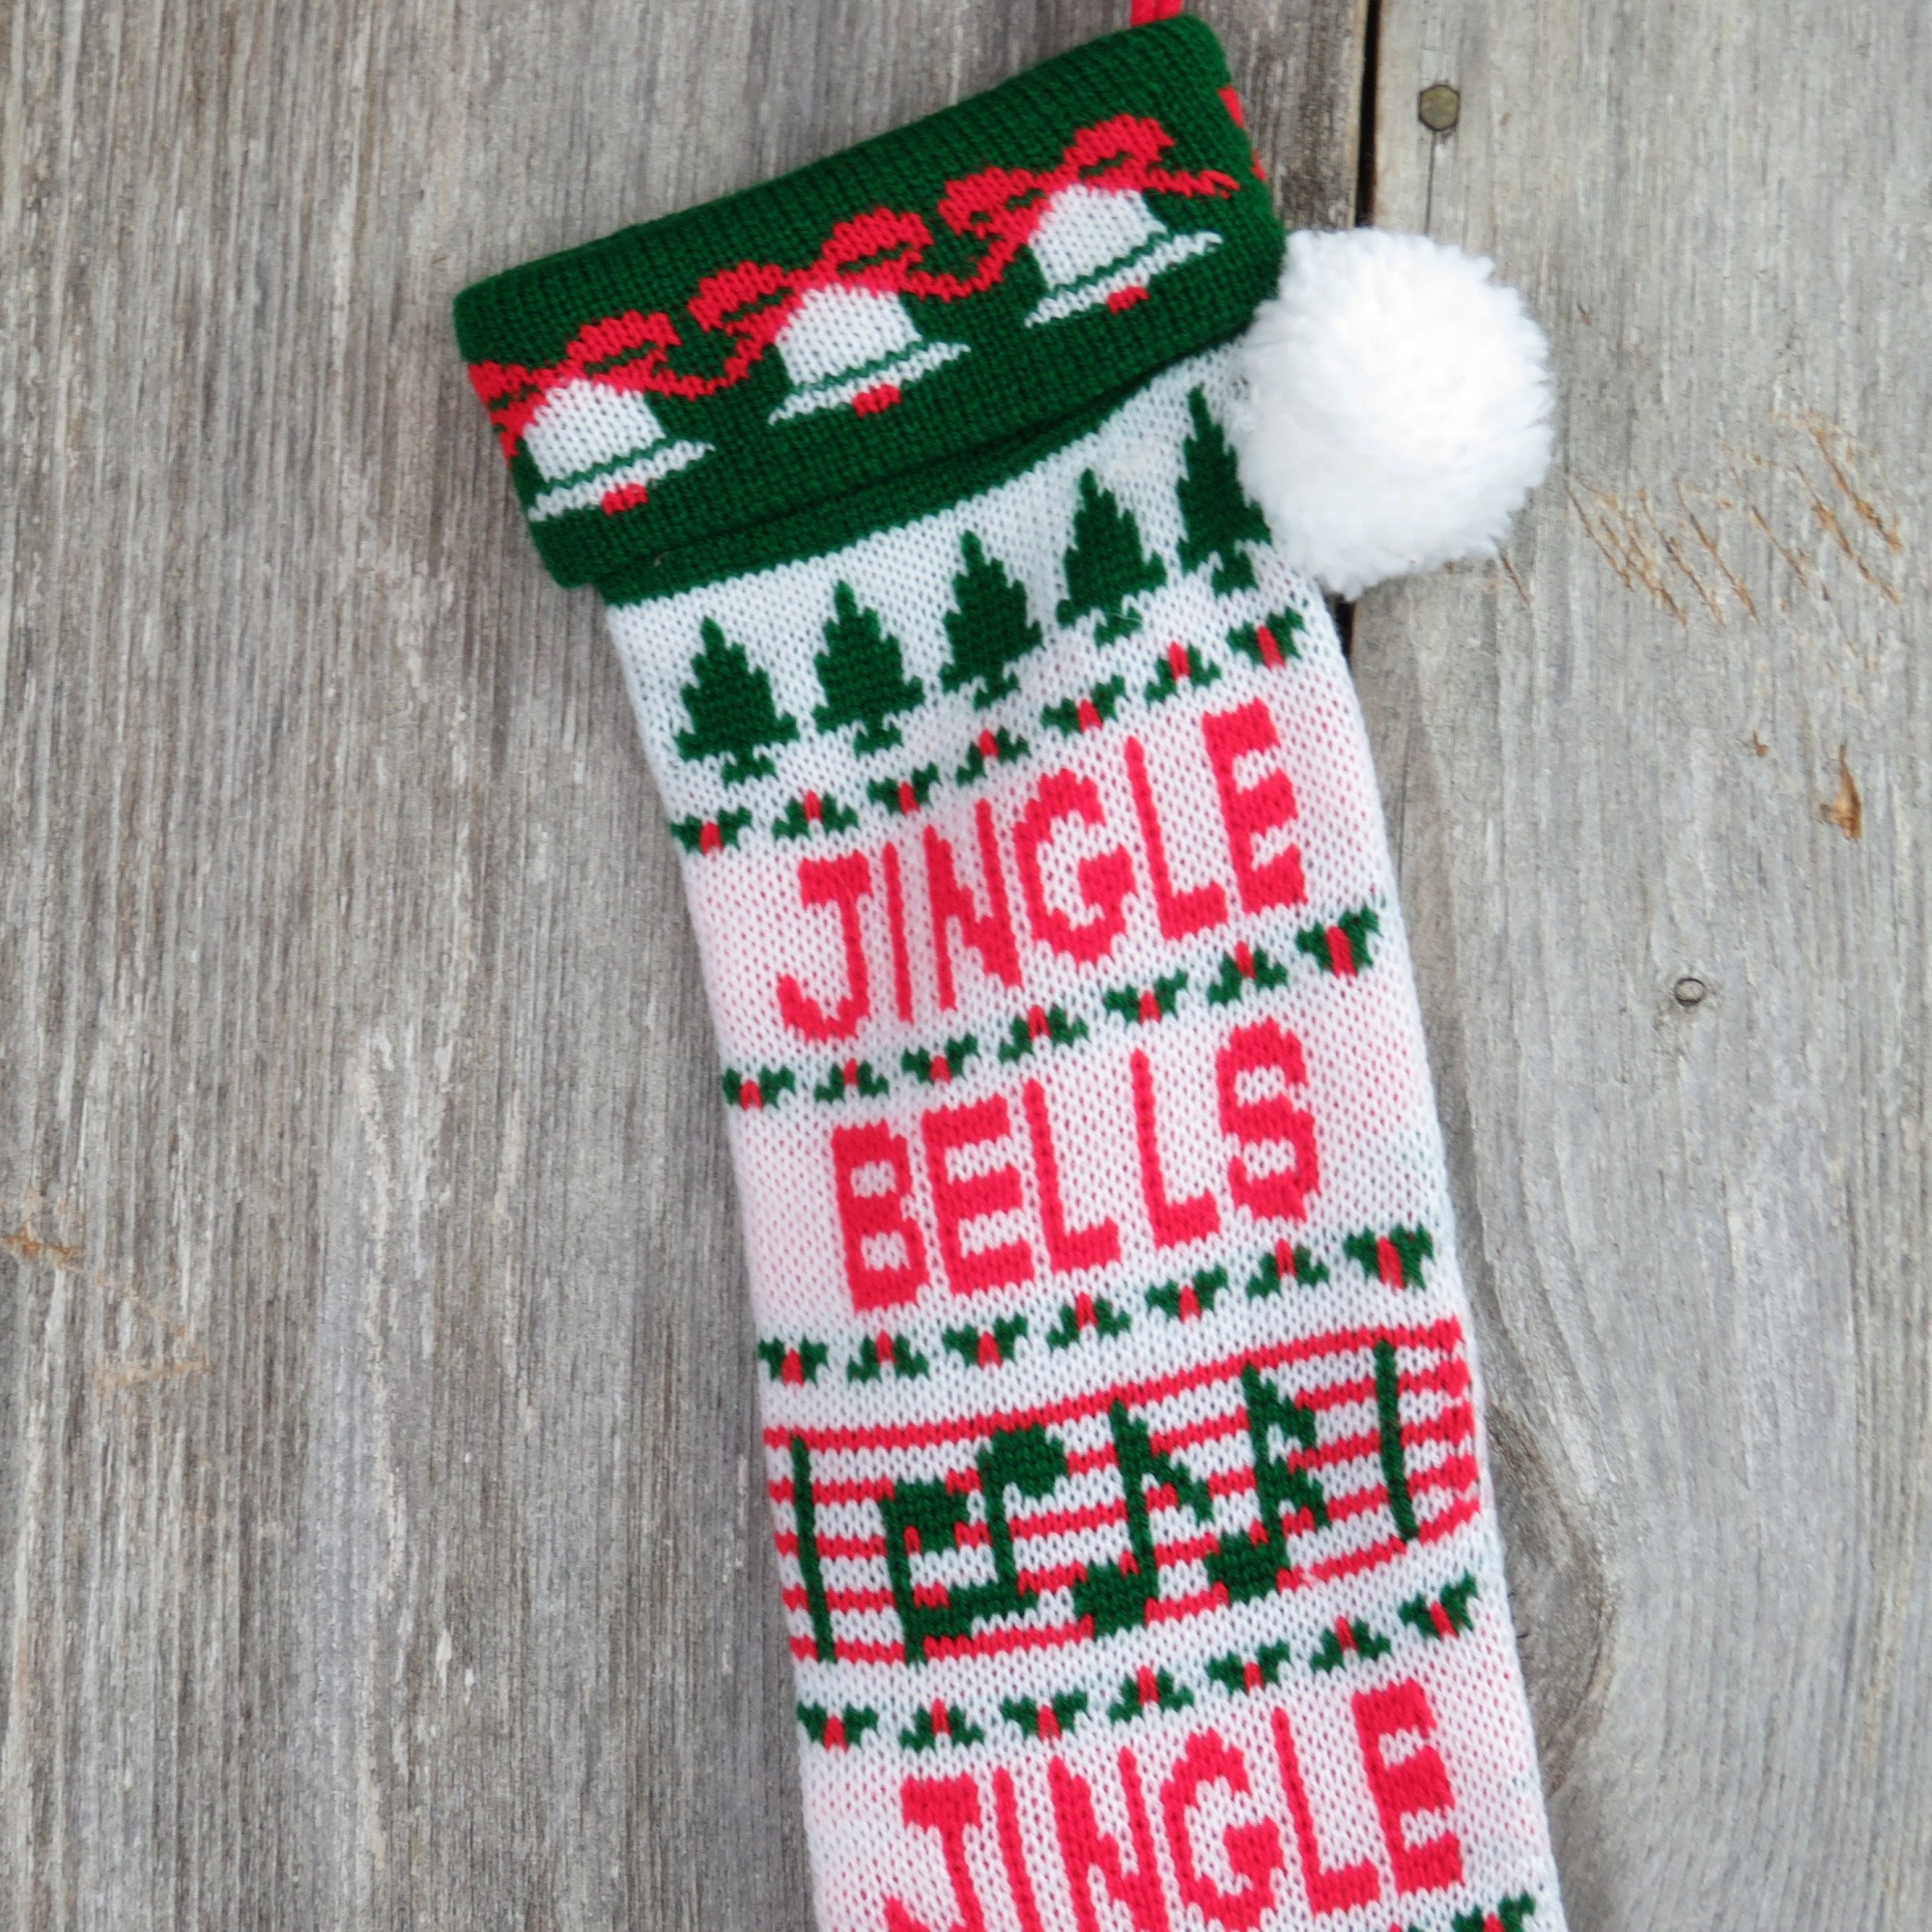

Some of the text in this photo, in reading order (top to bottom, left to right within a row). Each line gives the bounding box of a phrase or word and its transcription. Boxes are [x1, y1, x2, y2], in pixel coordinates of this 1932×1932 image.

[776, 697, 1309, 1044] JINGLE
[831, 1016, 1321, 1314] BELLS
[883, 1677, 1465, 1932] JINGLE
